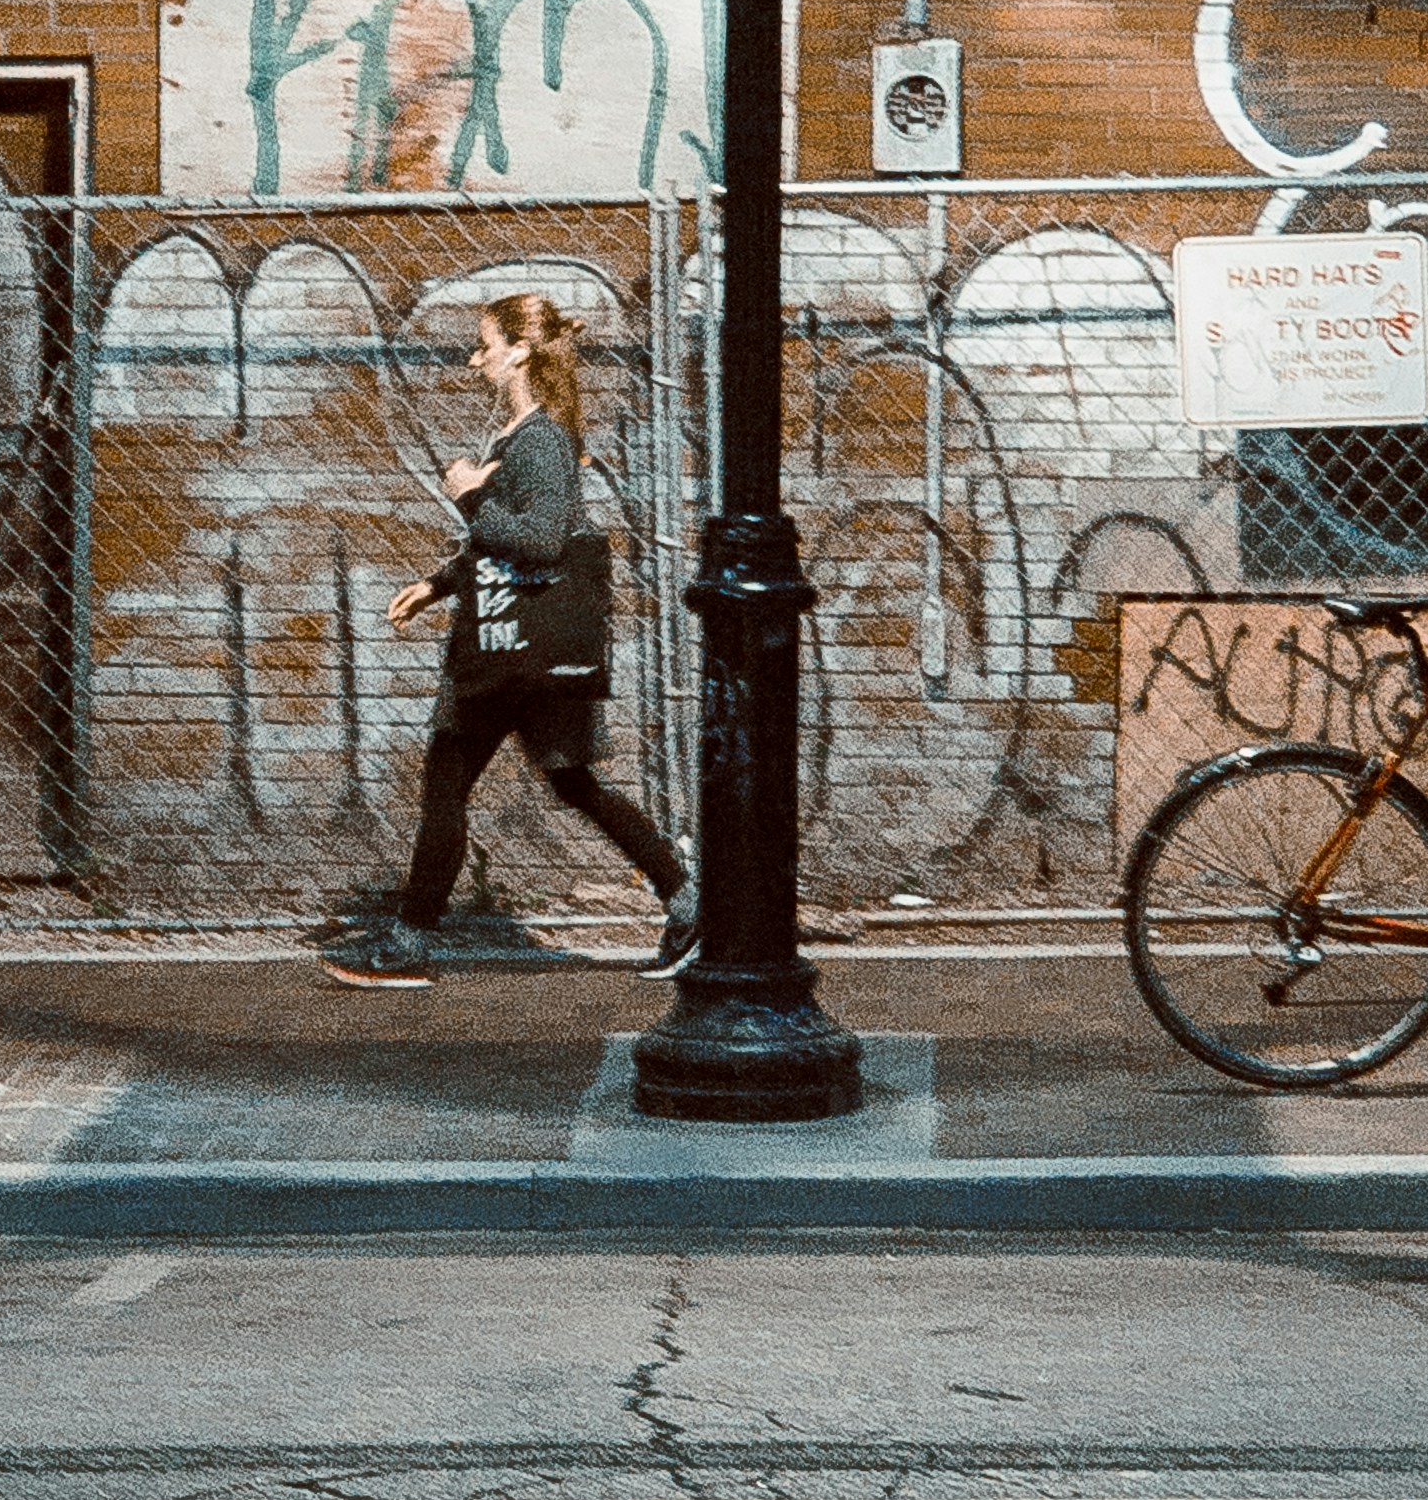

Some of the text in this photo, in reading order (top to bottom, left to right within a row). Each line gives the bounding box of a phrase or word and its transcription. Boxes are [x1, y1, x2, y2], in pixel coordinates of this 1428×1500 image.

[1227, 263, 1383, 288] HARD HATS
[1285, 296, 1320, 311] AND
[1206, 316, 1405, 344] STY BOOTS
[1302, 364, 1375, 380] PROJECT
